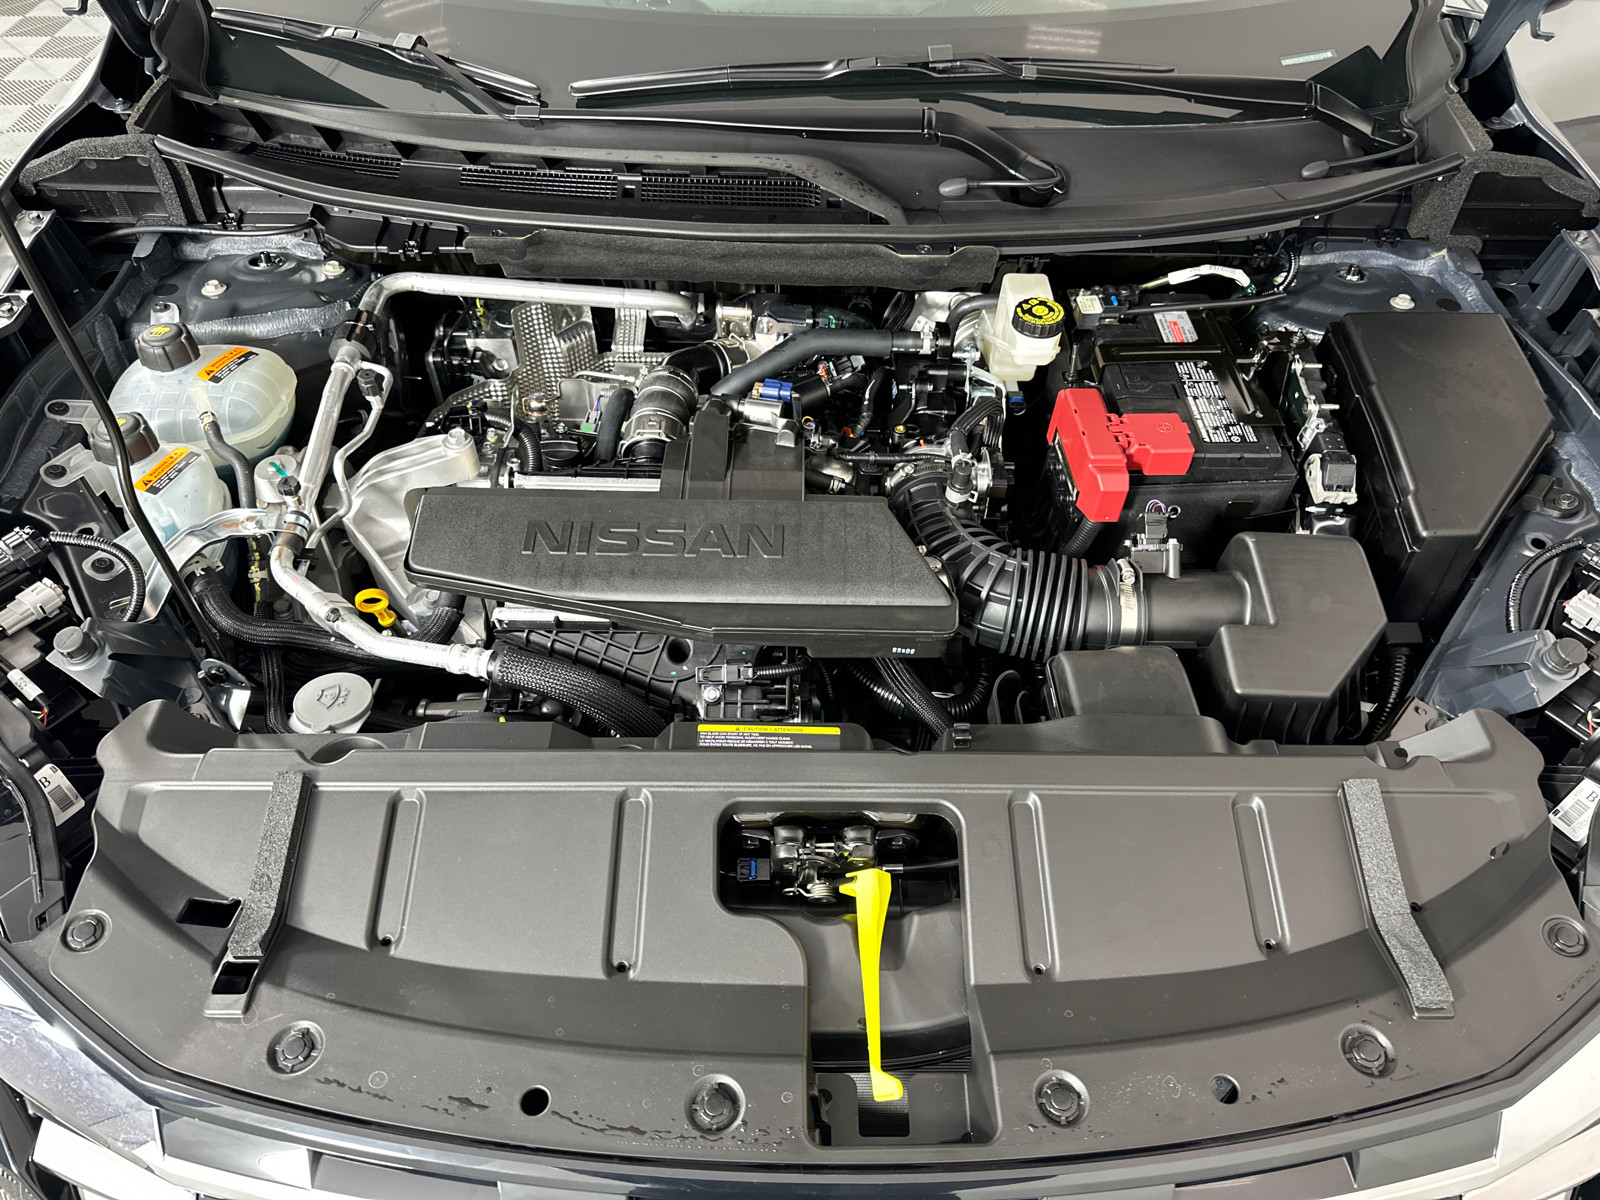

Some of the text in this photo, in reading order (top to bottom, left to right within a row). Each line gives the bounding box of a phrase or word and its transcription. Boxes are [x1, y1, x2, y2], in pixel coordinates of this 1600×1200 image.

[521, 519, 784, 558] NISSAN
[38, 776, 51, 789] B
[1585, 790, 1599, 803] B
